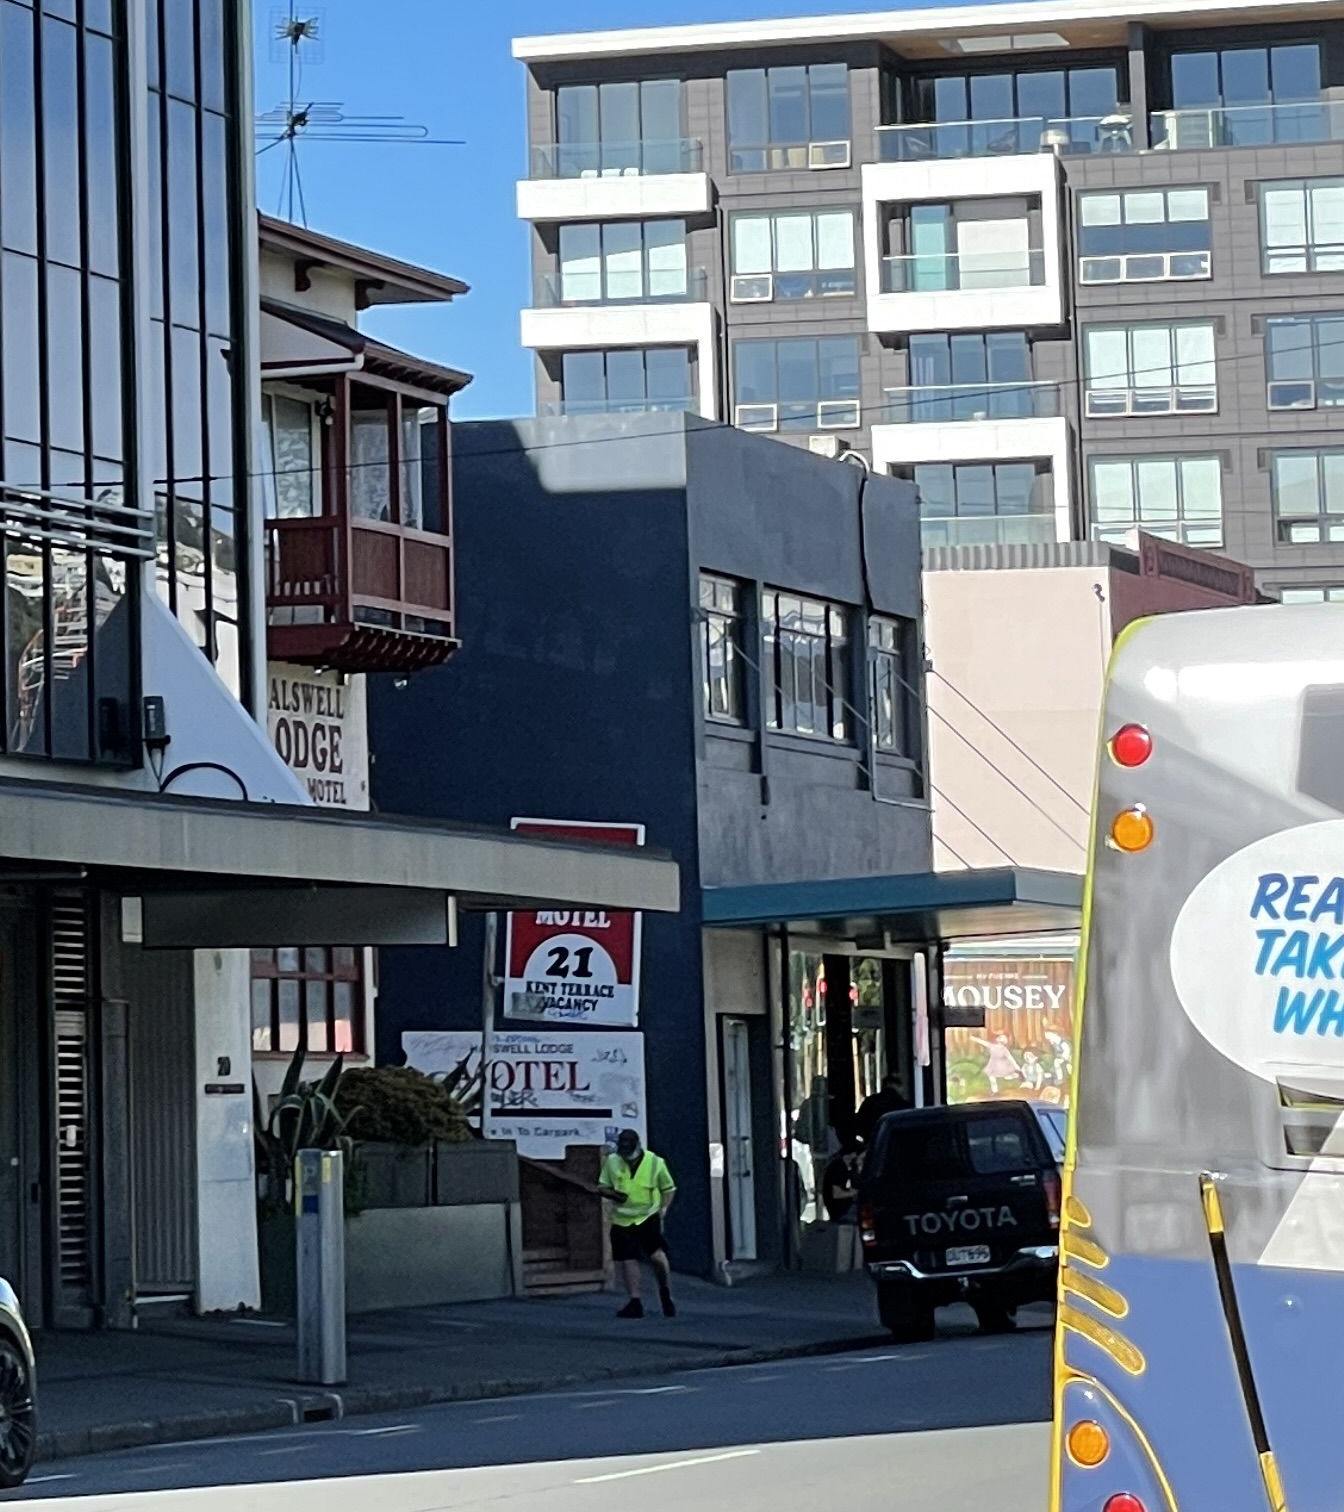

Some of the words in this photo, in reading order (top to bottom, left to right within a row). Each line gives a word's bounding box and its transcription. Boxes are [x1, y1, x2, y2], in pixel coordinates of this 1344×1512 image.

[269, 678, 344, 719] ALSWELL
[275, 717, 343, 774] ODGE
[545, 946, 594, 979] 21
[1255, 929, 1344, 980] TAK
[525, 981, 558, 996] KENT
[560, 982, 615, 999] TERRACE
[535, 1043, 574, 1055] LODGE
[903, 1205, 1018, 1236] TOYOTA
